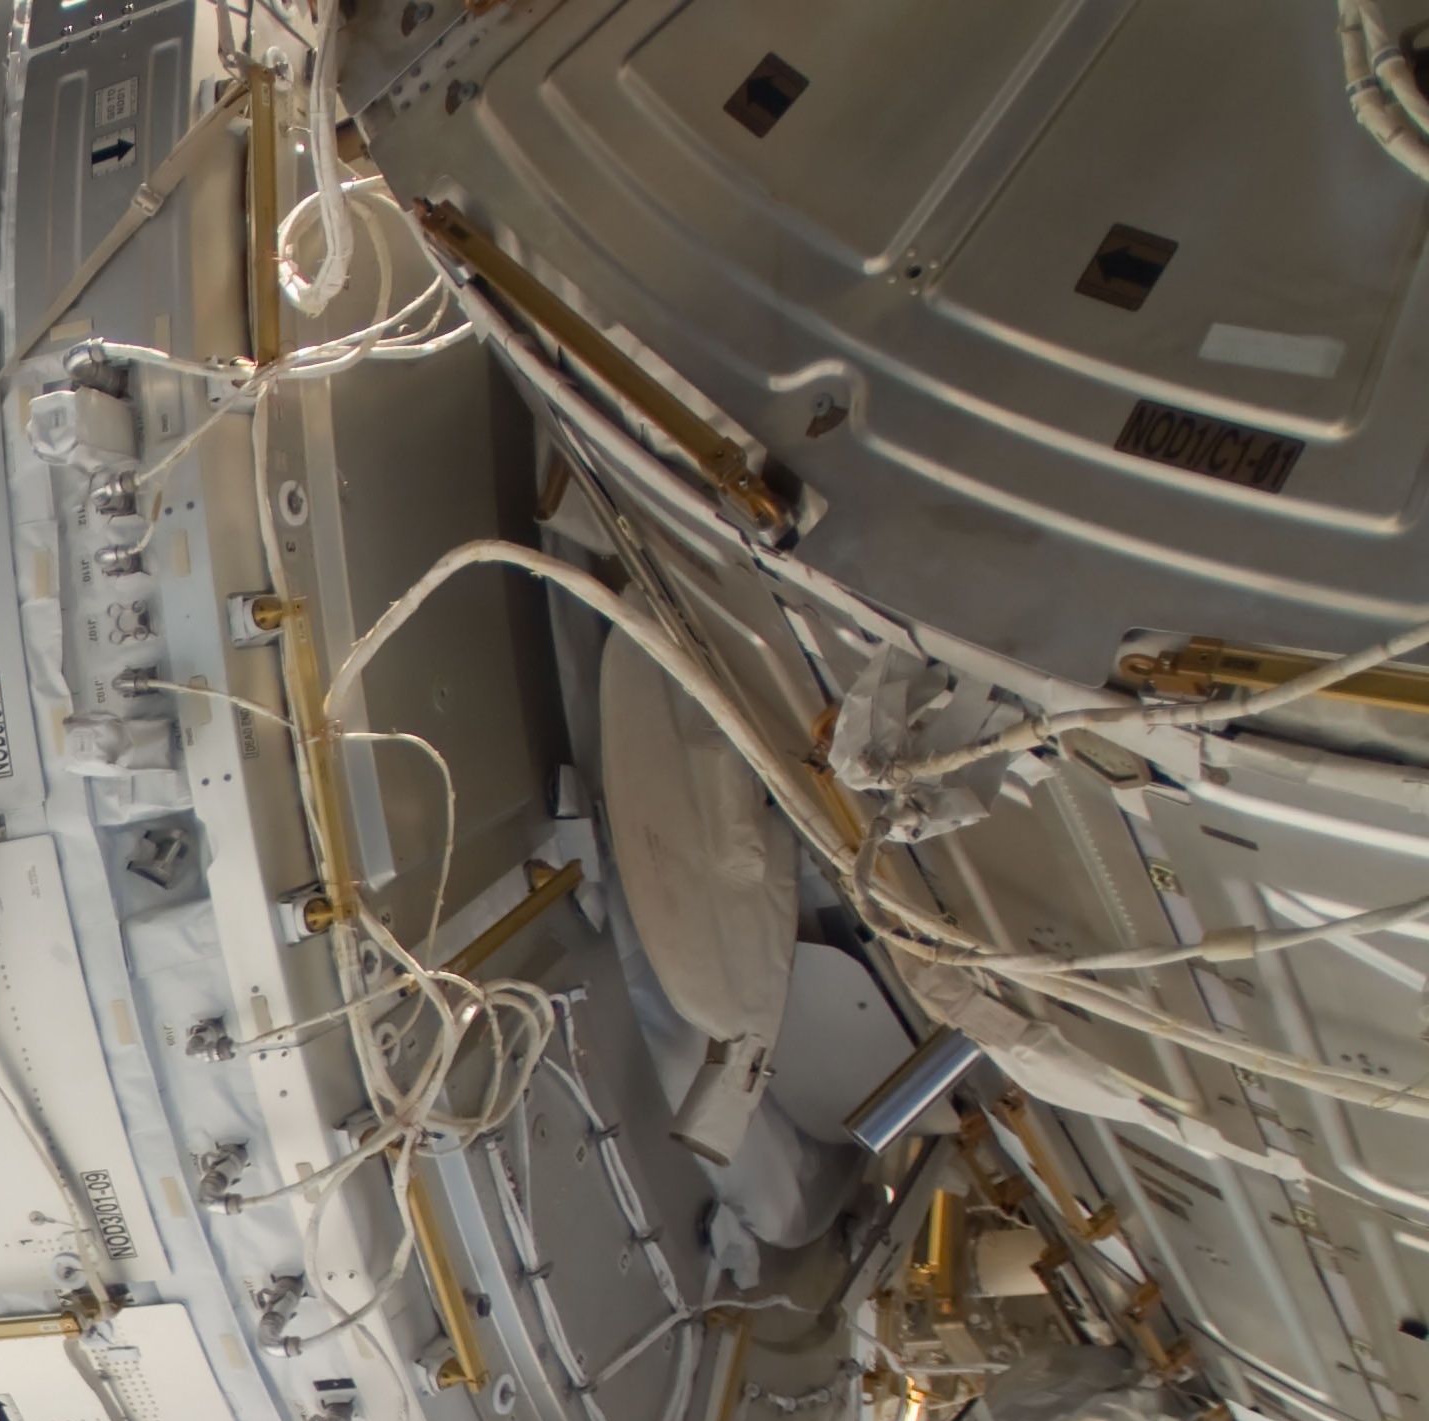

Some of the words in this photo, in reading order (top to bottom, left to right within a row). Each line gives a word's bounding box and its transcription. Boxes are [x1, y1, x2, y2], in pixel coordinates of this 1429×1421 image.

[1122, 405, 1297, 489] NOD1/C1-01
[285, 542, 296, 552] 3
[85, 1172, 133, 1259] NOD3/01-09
